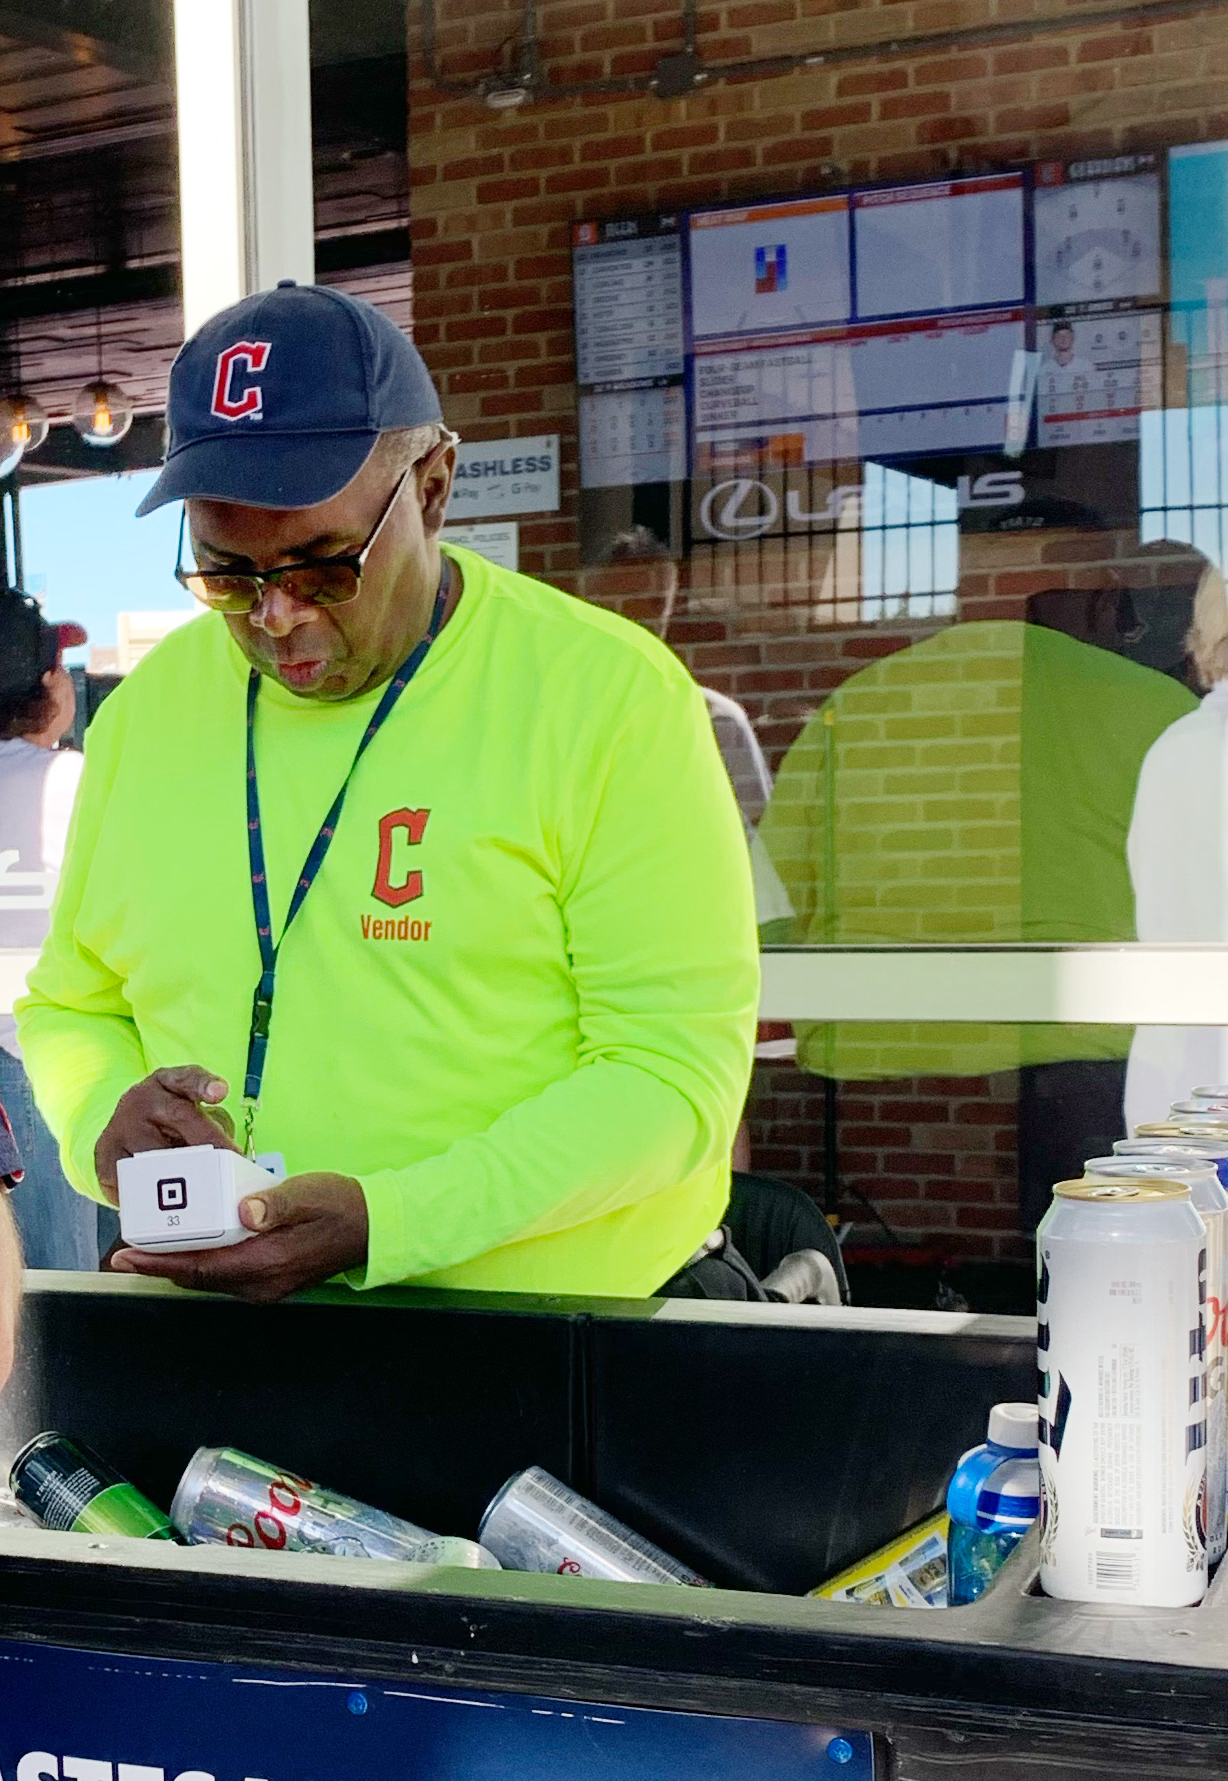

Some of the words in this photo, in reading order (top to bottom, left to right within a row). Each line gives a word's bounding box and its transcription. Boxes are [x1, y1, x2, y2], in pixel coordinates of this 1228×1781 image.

[210, 341, 272, 422] C
[455, 455, 551, 480] ASHLESS
[787, 471, 1026, 521] LES
[371, 807, 431, 909] C
[360, 914, 433, 942] Vendor
[166, 1215, 181, 1227] 33
